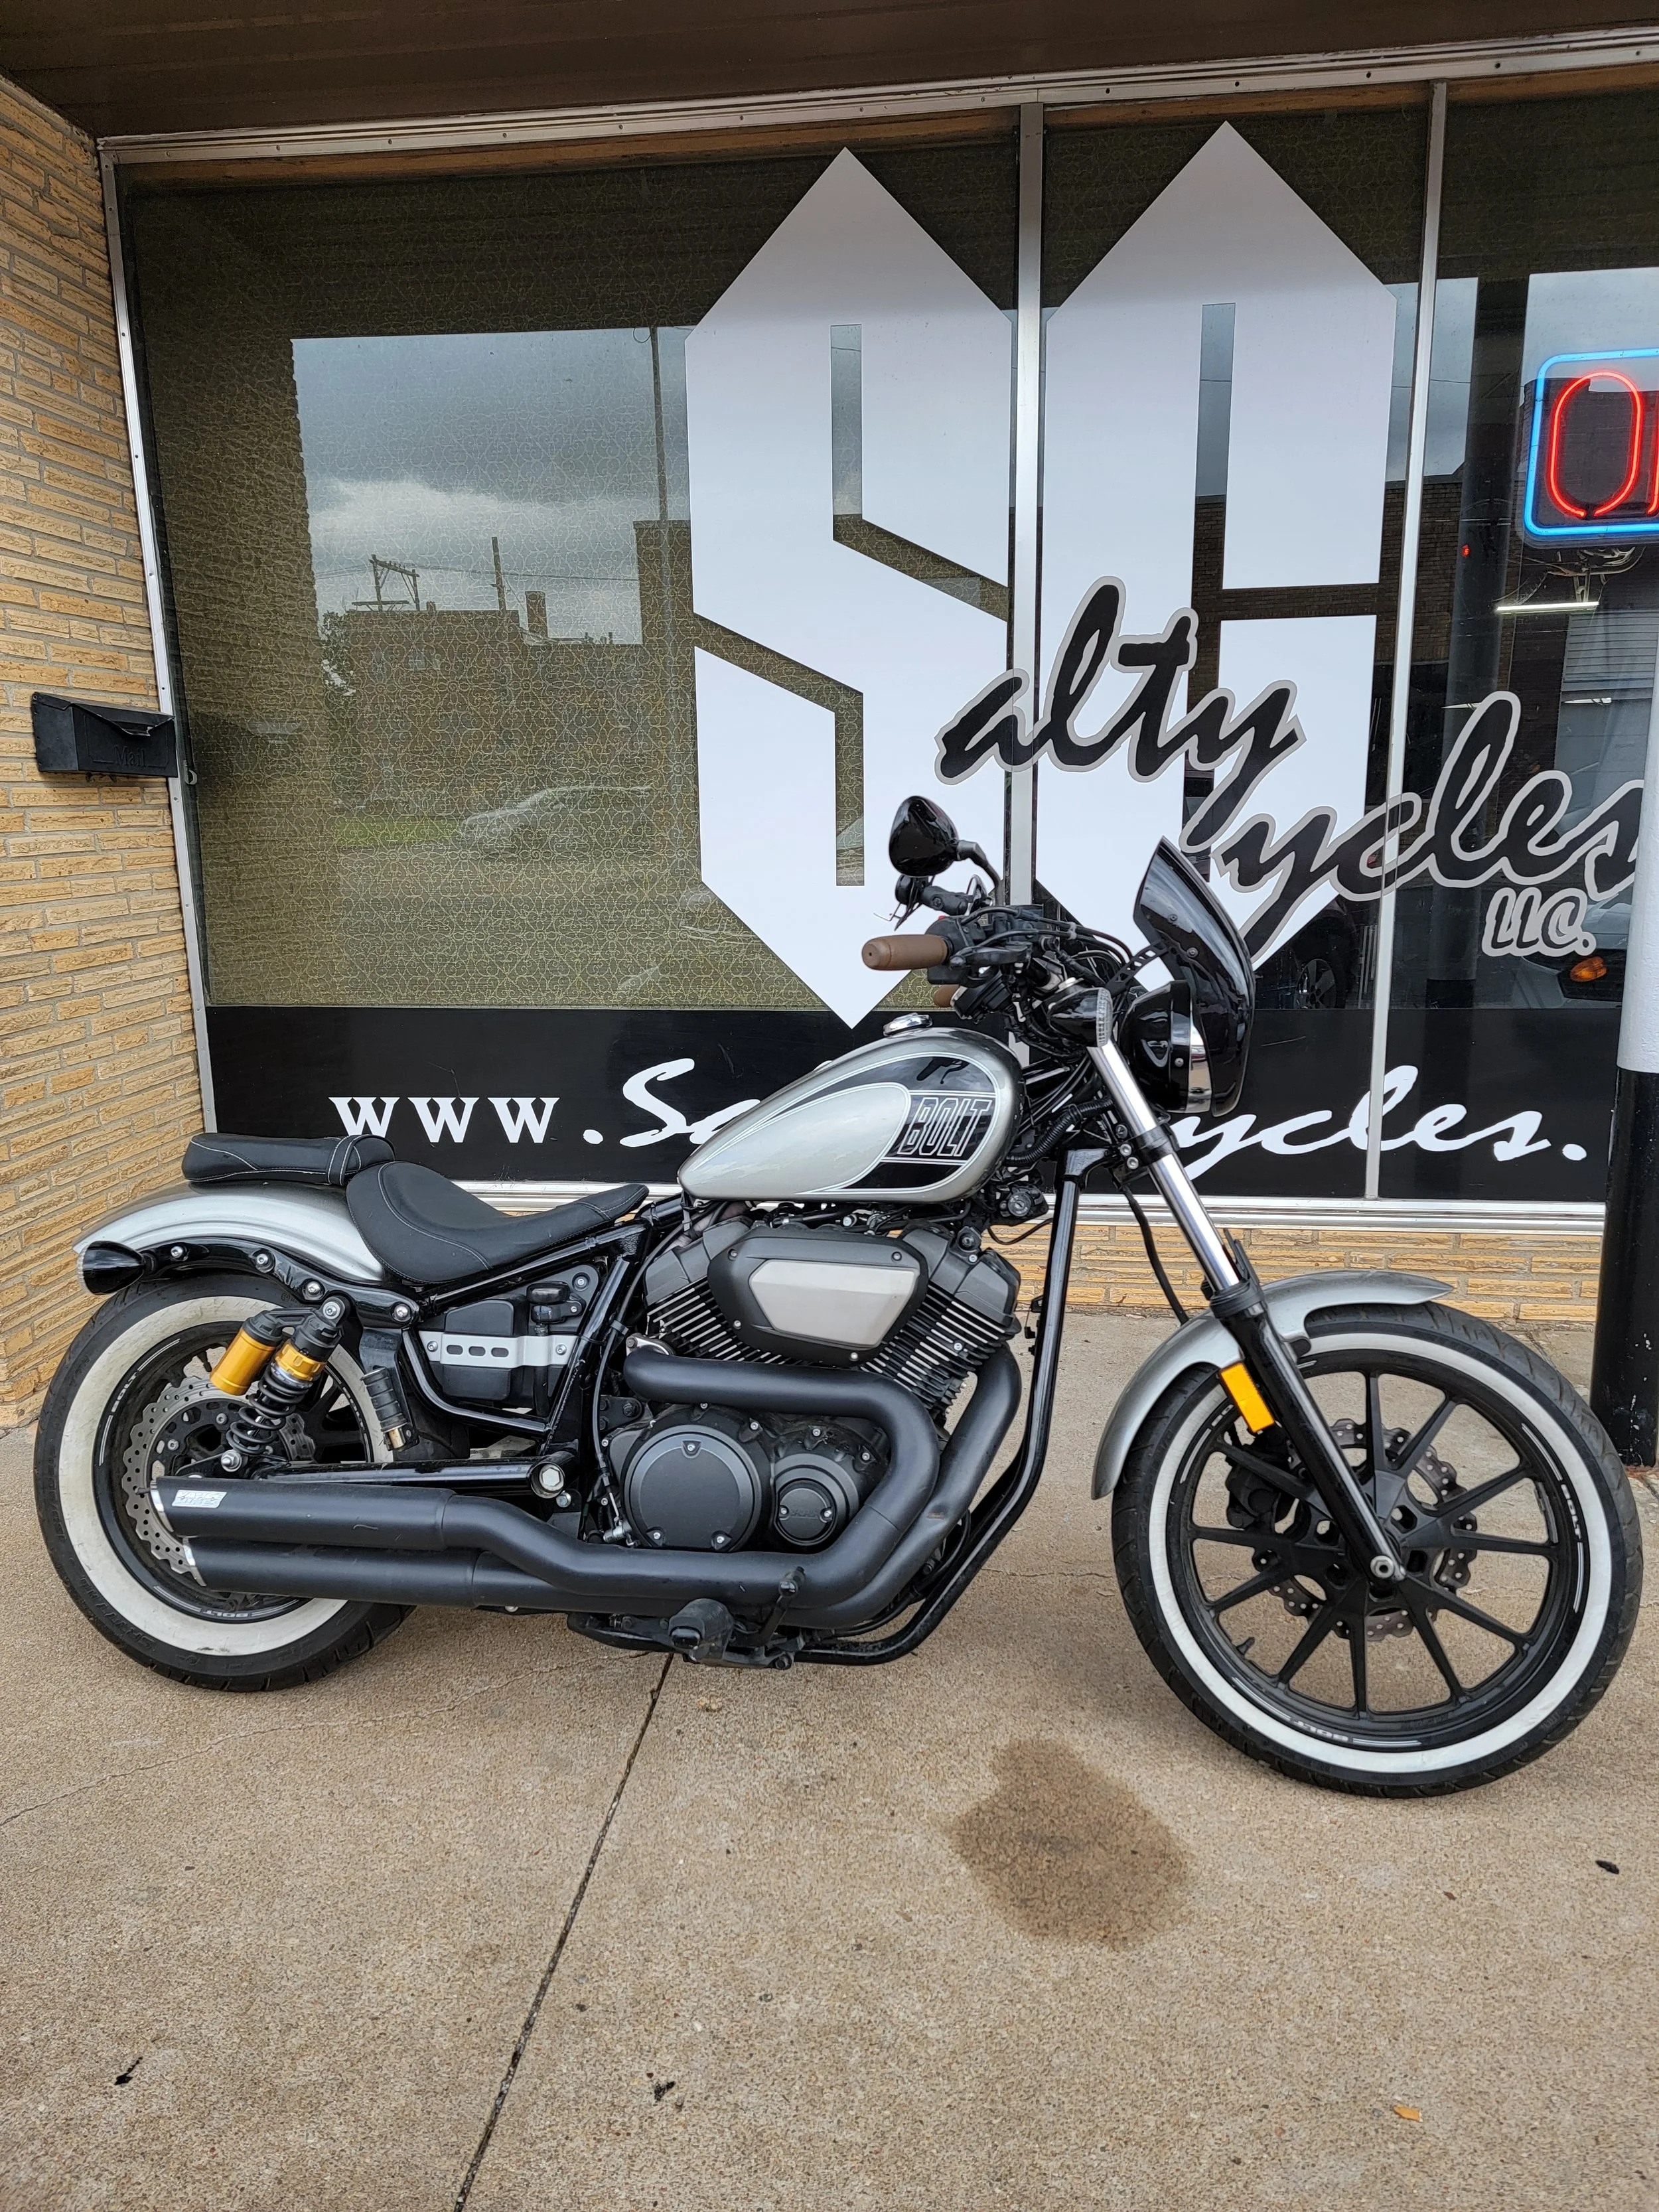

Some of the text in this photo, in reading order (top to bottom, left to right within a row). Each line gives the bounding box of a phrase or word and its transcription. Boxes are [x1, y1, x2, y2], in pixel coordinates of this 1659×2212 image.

[113, 745, 147, 769] Mail
[897, 1097, 993, 1157] BOLT
[202, 1609, 249, 1618] BOLT
